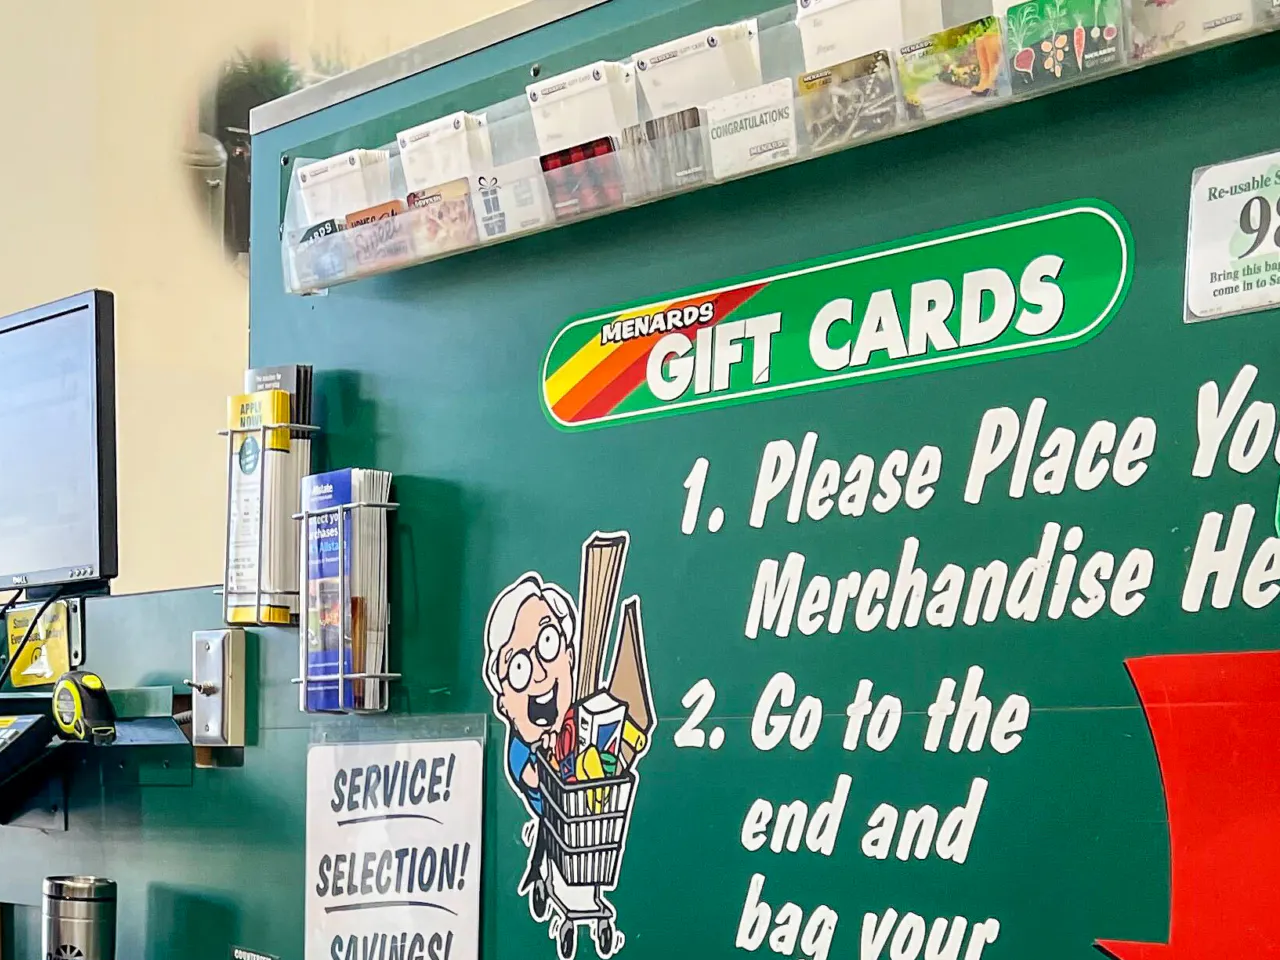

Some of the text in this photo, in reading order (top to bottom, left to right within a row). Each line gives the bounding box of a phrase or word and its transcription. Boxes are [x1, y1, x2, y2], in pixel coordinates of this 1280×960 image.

[711, 106, 790, 140] CONGRATULATIONS
[1207, 173, 1272, 201] Re-usable
[1238, 195, 1280, 260] 9
[1210, 268, 1239, 284] Bring
[1242, 263, 1262, 277] this
[1213, 282, 1239, 297] come
[1242, 280, 1253, 292] in
[1256, 277, 1267, 289] to
[601, 302, 714, 345] MENARDS
[646, 254, 1065, 401] GIFT CARDS
[240, 401, 261, 415] APPLY
[681, 365, 1280, 535] 1. Please Place Yo
[745, 521, 1154, 639] Merchandise
[673, 665, 1031, 754] 2. Go to the
[331, 753, 456, 813] SERVICE!
[741, 773, 988, 864] end and
[316, 842, 470, 897] SELECTION!
